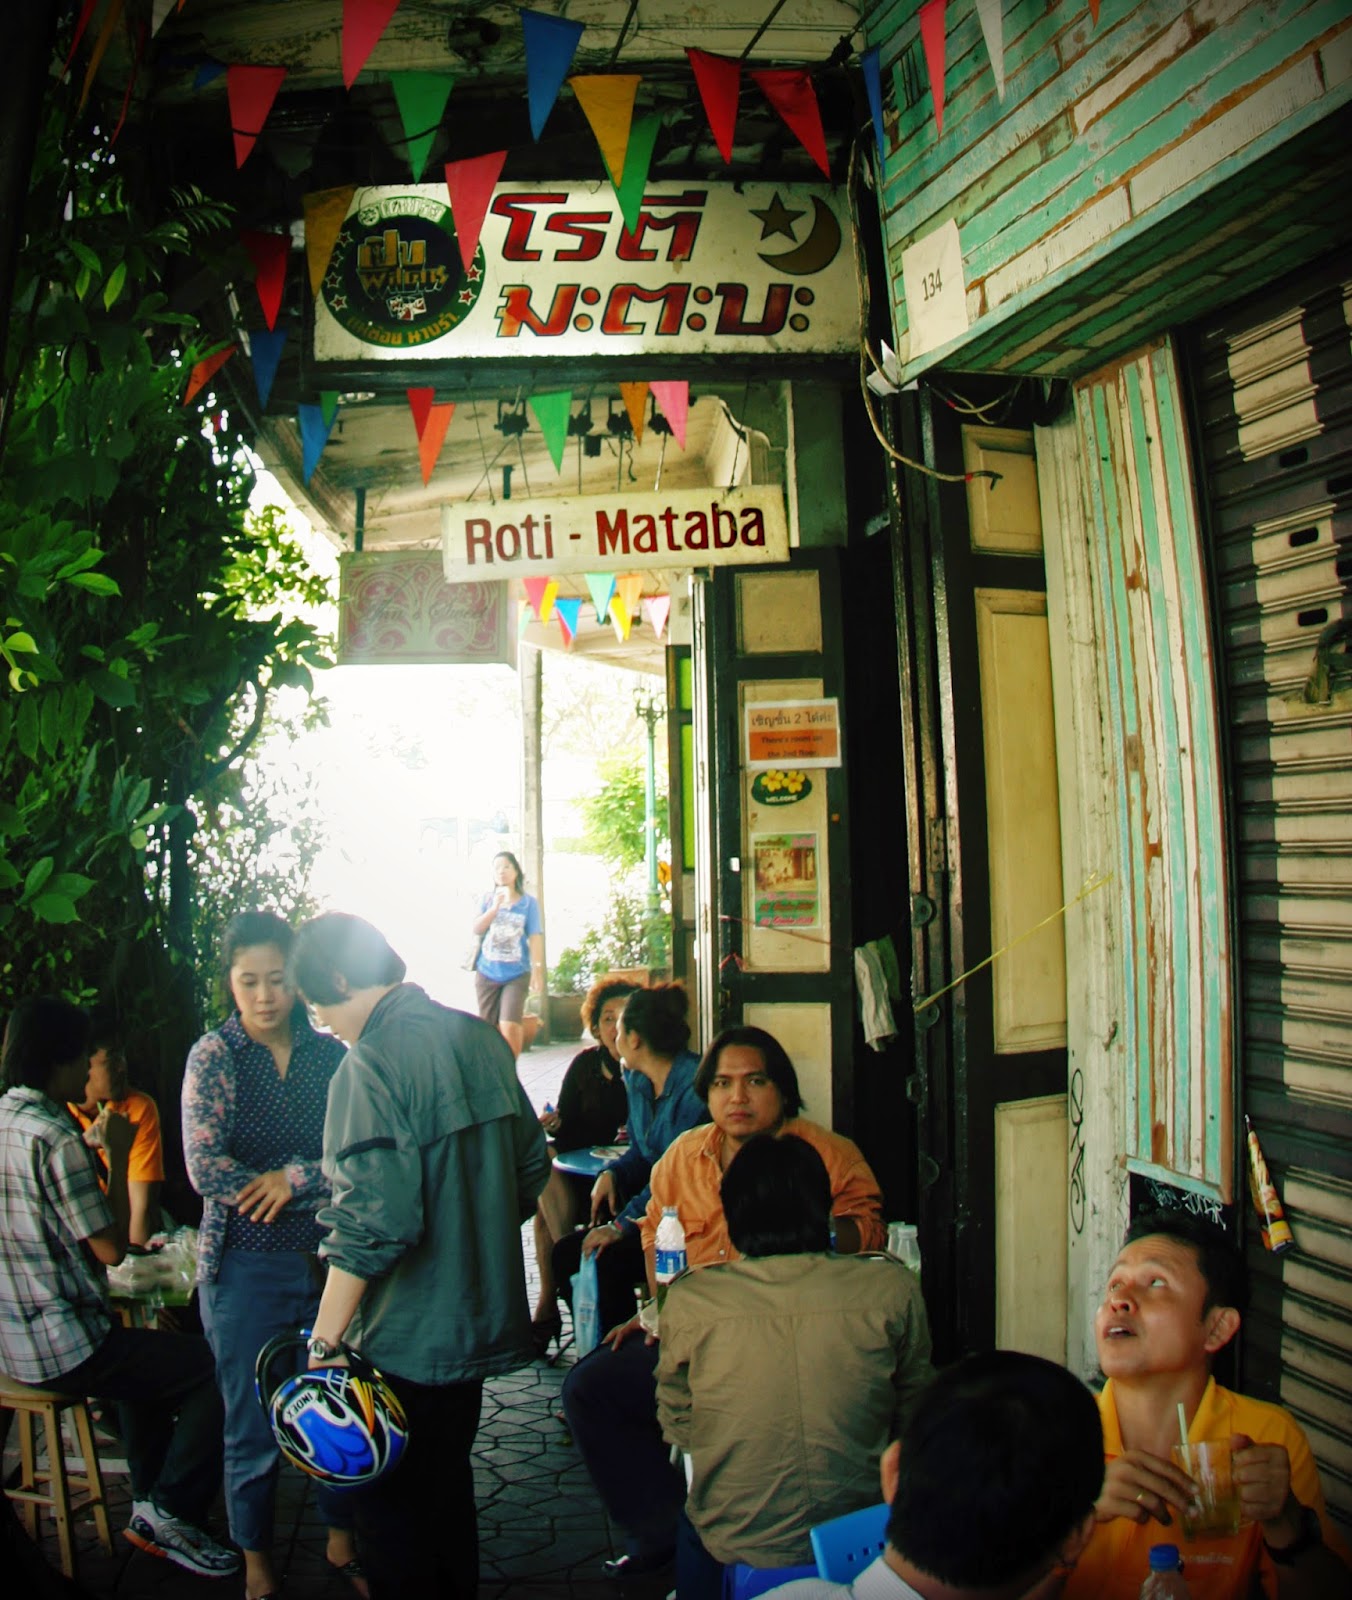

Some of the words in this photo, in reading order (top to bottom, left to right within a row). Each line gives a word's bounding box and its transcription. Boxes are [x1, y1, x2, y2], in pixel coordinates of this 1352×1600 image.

[491, 190, 706, 261] โรตี
[922, 268, 943, 301] 134
[496, 283, 815, 337] มะตะบะ
[465, 514, 554, 565] Roti
[596, 502, 766, 556] Mataba
[794, 713, 801, 724] 2
[286, 1392, 313, 1420] INDEX
